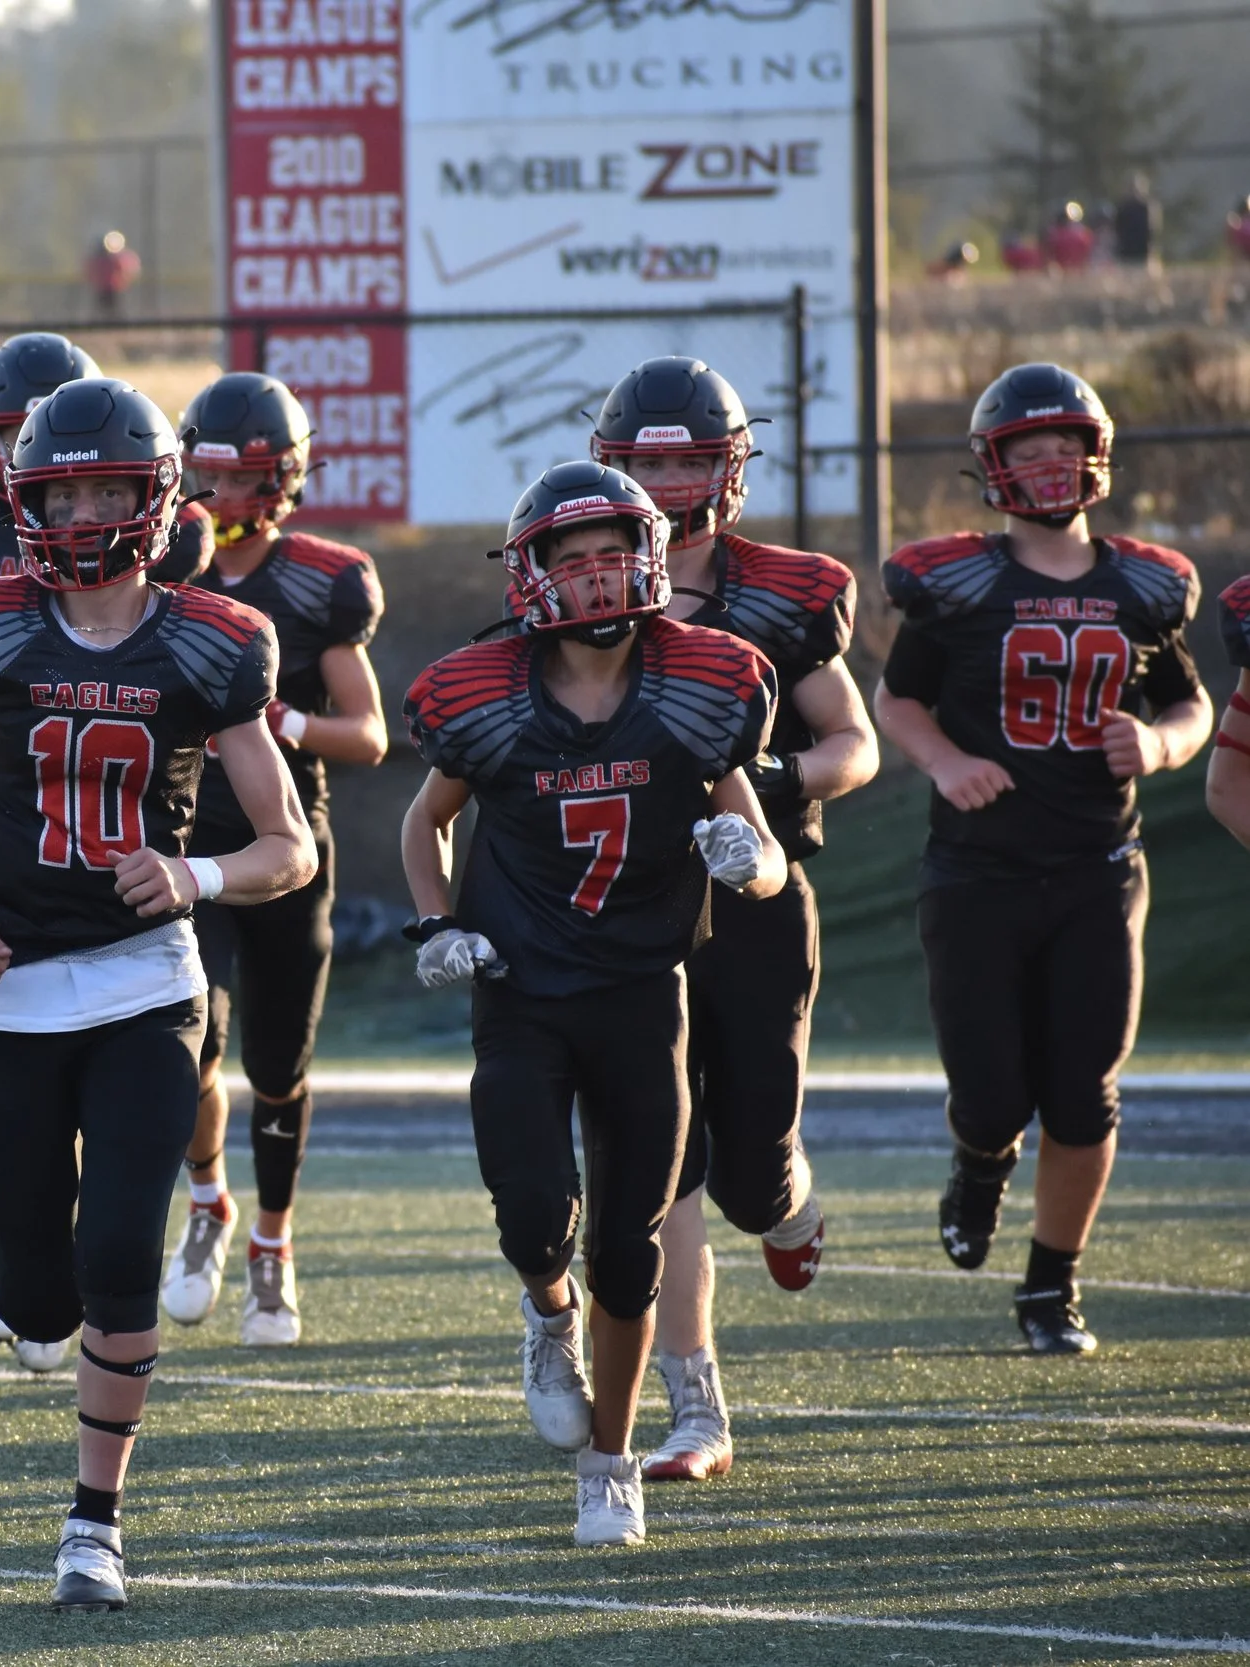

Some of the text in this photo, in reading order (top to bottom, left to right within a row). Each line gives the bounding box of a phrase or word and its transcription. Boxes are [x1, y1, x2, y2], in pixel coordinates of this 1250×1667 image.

[235, 0, 398, 46] LEAGUE
[235, 54, 399, 109] CHAMPS
[501, 52, 845, 93] TRUCKING
[268, 133, 365, 188] 2010
[440, 141, 822, 203] MOBILE ZONE
[236, 193, 401, 246] LEAGUE
[235, 255, 401, 309] CHAMPS
[557, 235, 721, 283] verizon
[52, 449, 98, 462] Riddell
[643, 429, 684, 438] Riddell
[560, 497, 604, 512] Riddell
[593, 624, 617, 635] Riddell
[1014, 599, 1118, 622] EAGLES
[29, 682, 161, 715] EAGLES
[1000, 624, 1130, 751] 60
[28, 716, 155, 872] 10
[534, 759, 651, 797] EAGLES
[560, 793, 631, 917] 7
